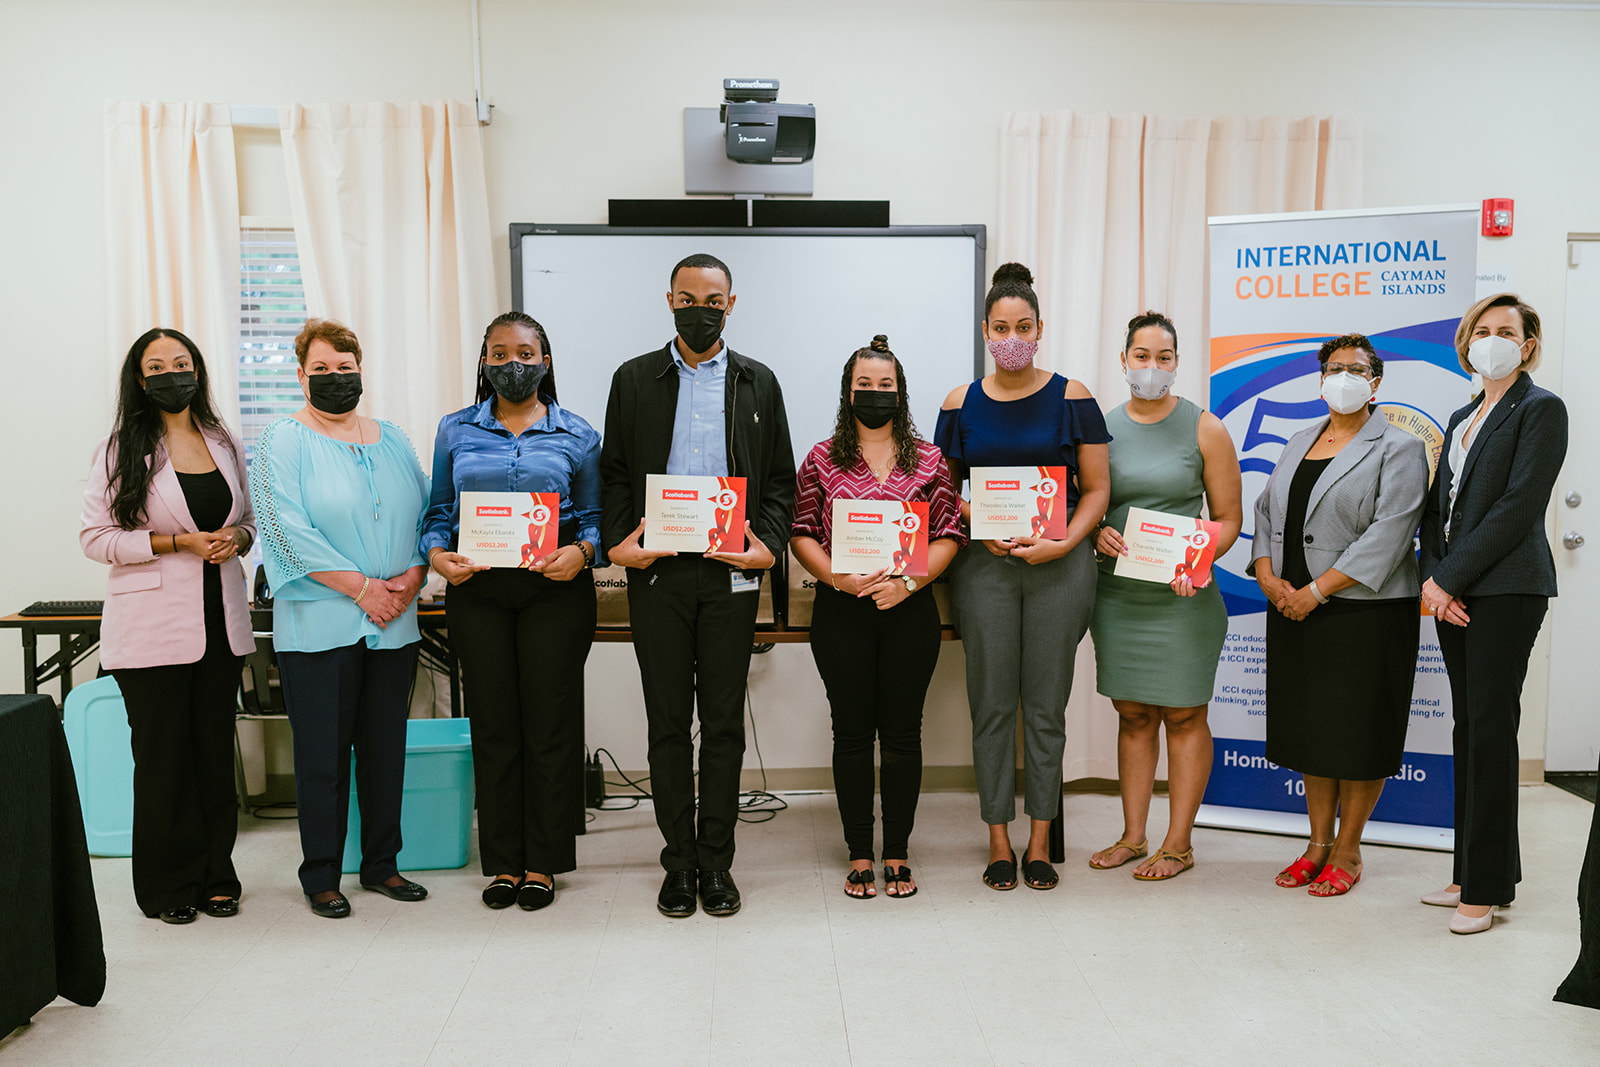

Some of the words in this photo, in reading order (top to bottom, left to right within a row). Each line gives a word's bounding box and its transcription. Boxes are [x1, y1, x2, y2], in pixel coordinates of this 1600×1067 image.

[730, 80, 773, 88] Promethean
[1237, 240, 1446, 268] INTERNATIONAL
[1381, 269, 1446, 282] CAYMAN
[1235, 271, 1371, 300] COLLEGE
[1382, 283, 1446, 295] ISLANDS
[1397, 411, 1407, 424] in
[1408, 415, 1436, 444] Higher
[595, 579, 627, 588] cotiab
[1225, 633, 1241, 642] CCI
[1419, 643, 1442, 652] sitiv
[1250, 646, 1266, 654] kno
[1227, 654, 1245, 663] ICCI
[1246, 657, 1266, 665] expe
[1222, 685, 1240, 694] ICCI
[1241, 688, 1267, 697] equip
[1214, 695, 1250, 707] thinking,
[1410, 698, 1440, 707] critical
[1247, 709, 1267, 717] succ
[1410, 708, 1430, 719] ning
[1432, 710, 1446, 718] for
[1284, 778, 1306, 797] 10
